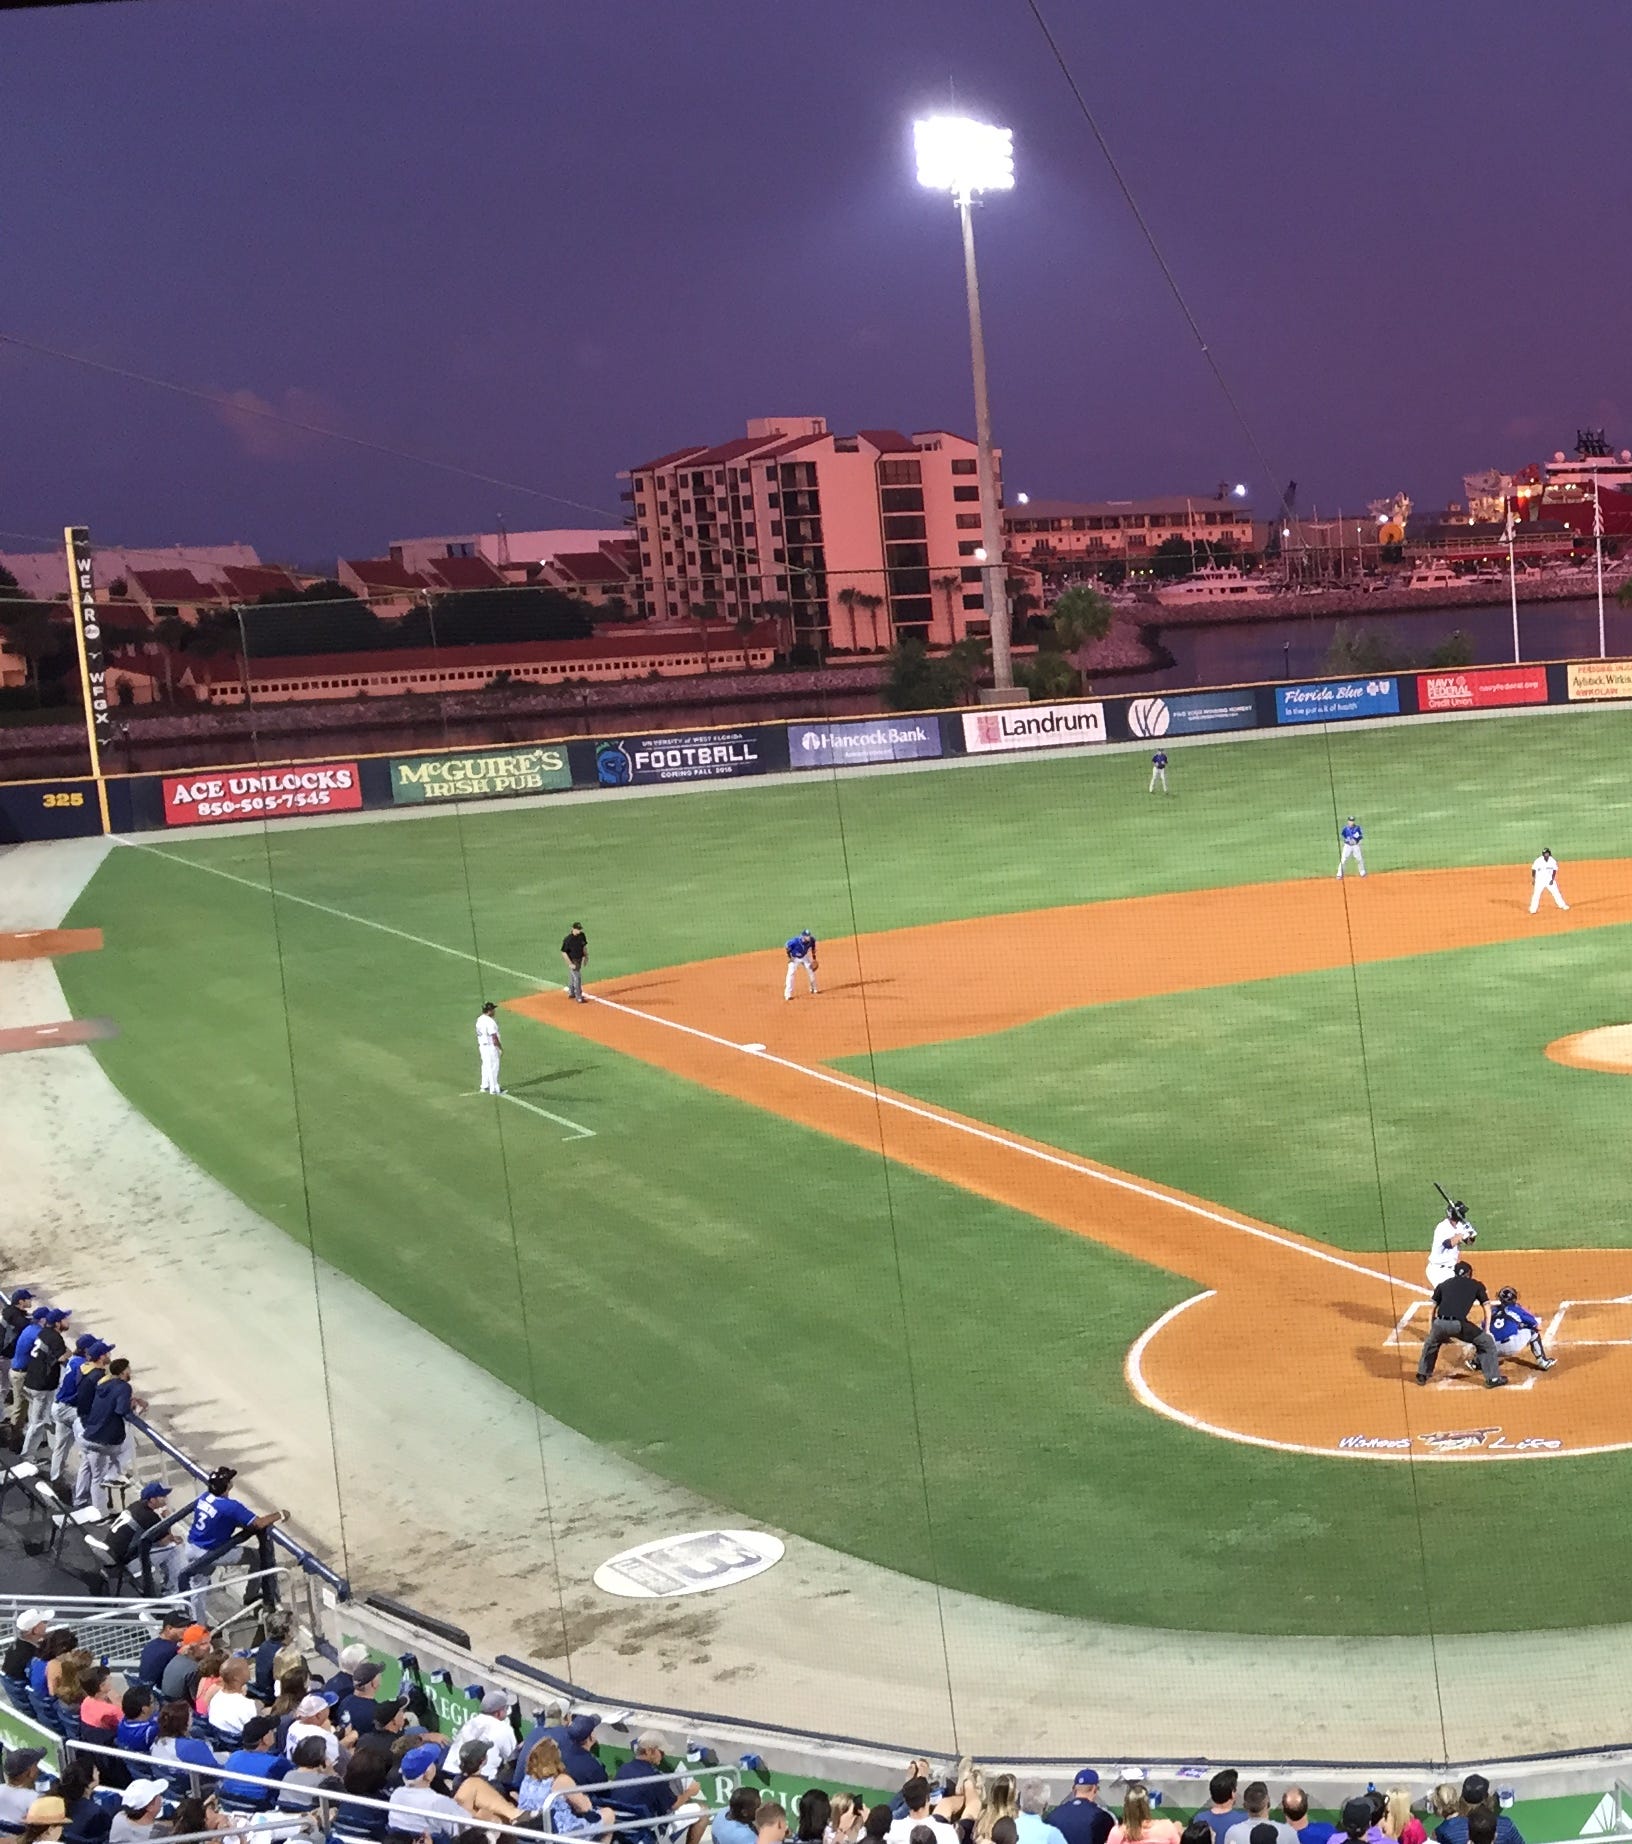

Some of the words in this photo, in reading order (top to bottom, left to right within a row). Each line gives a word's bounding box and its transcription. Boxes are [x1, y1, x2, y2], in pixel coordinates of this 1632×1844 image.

[76, 558, 96, 621] WEAR
[1427, 678, 1454, 688] NAVY
[1427, 685, 1471, 697] FEDERAL
[1478, 681, 1539, 693] navyfederal.org
[1284, 686, 1334, 703] Florida
[1336, 685, 1364, 699] Blue
[1428, 698, 1451, 708] Credit
[1451, 697, 1473, 707] Union
[1305, 705, 1329, 716] puruit
[1001, 711, 1098, 736] Landrum
[641, 738, 682, 747] UNVERSITY
[820, 730, 887, 749] Hancock
[889, 726, 927, 743] Bank
[635, 744, 758, 769] FOOTBALL
[398, 750, 563, 784] McGUIRE'S
[661, 769, 692, 778] COMING
[694, 768, 712, 776] FALL
[173, 781, 225, 804] ACE
[229, 770, 352, 795] UNLOCKS
[424, 779, 490, 797] IRISH
[495, 774, 543, 791] PUB
[42, 792, 84, 808] 325
[198, 791, 331, 816] 850-505-7545
[195, 1512, 208, 1531] 3
